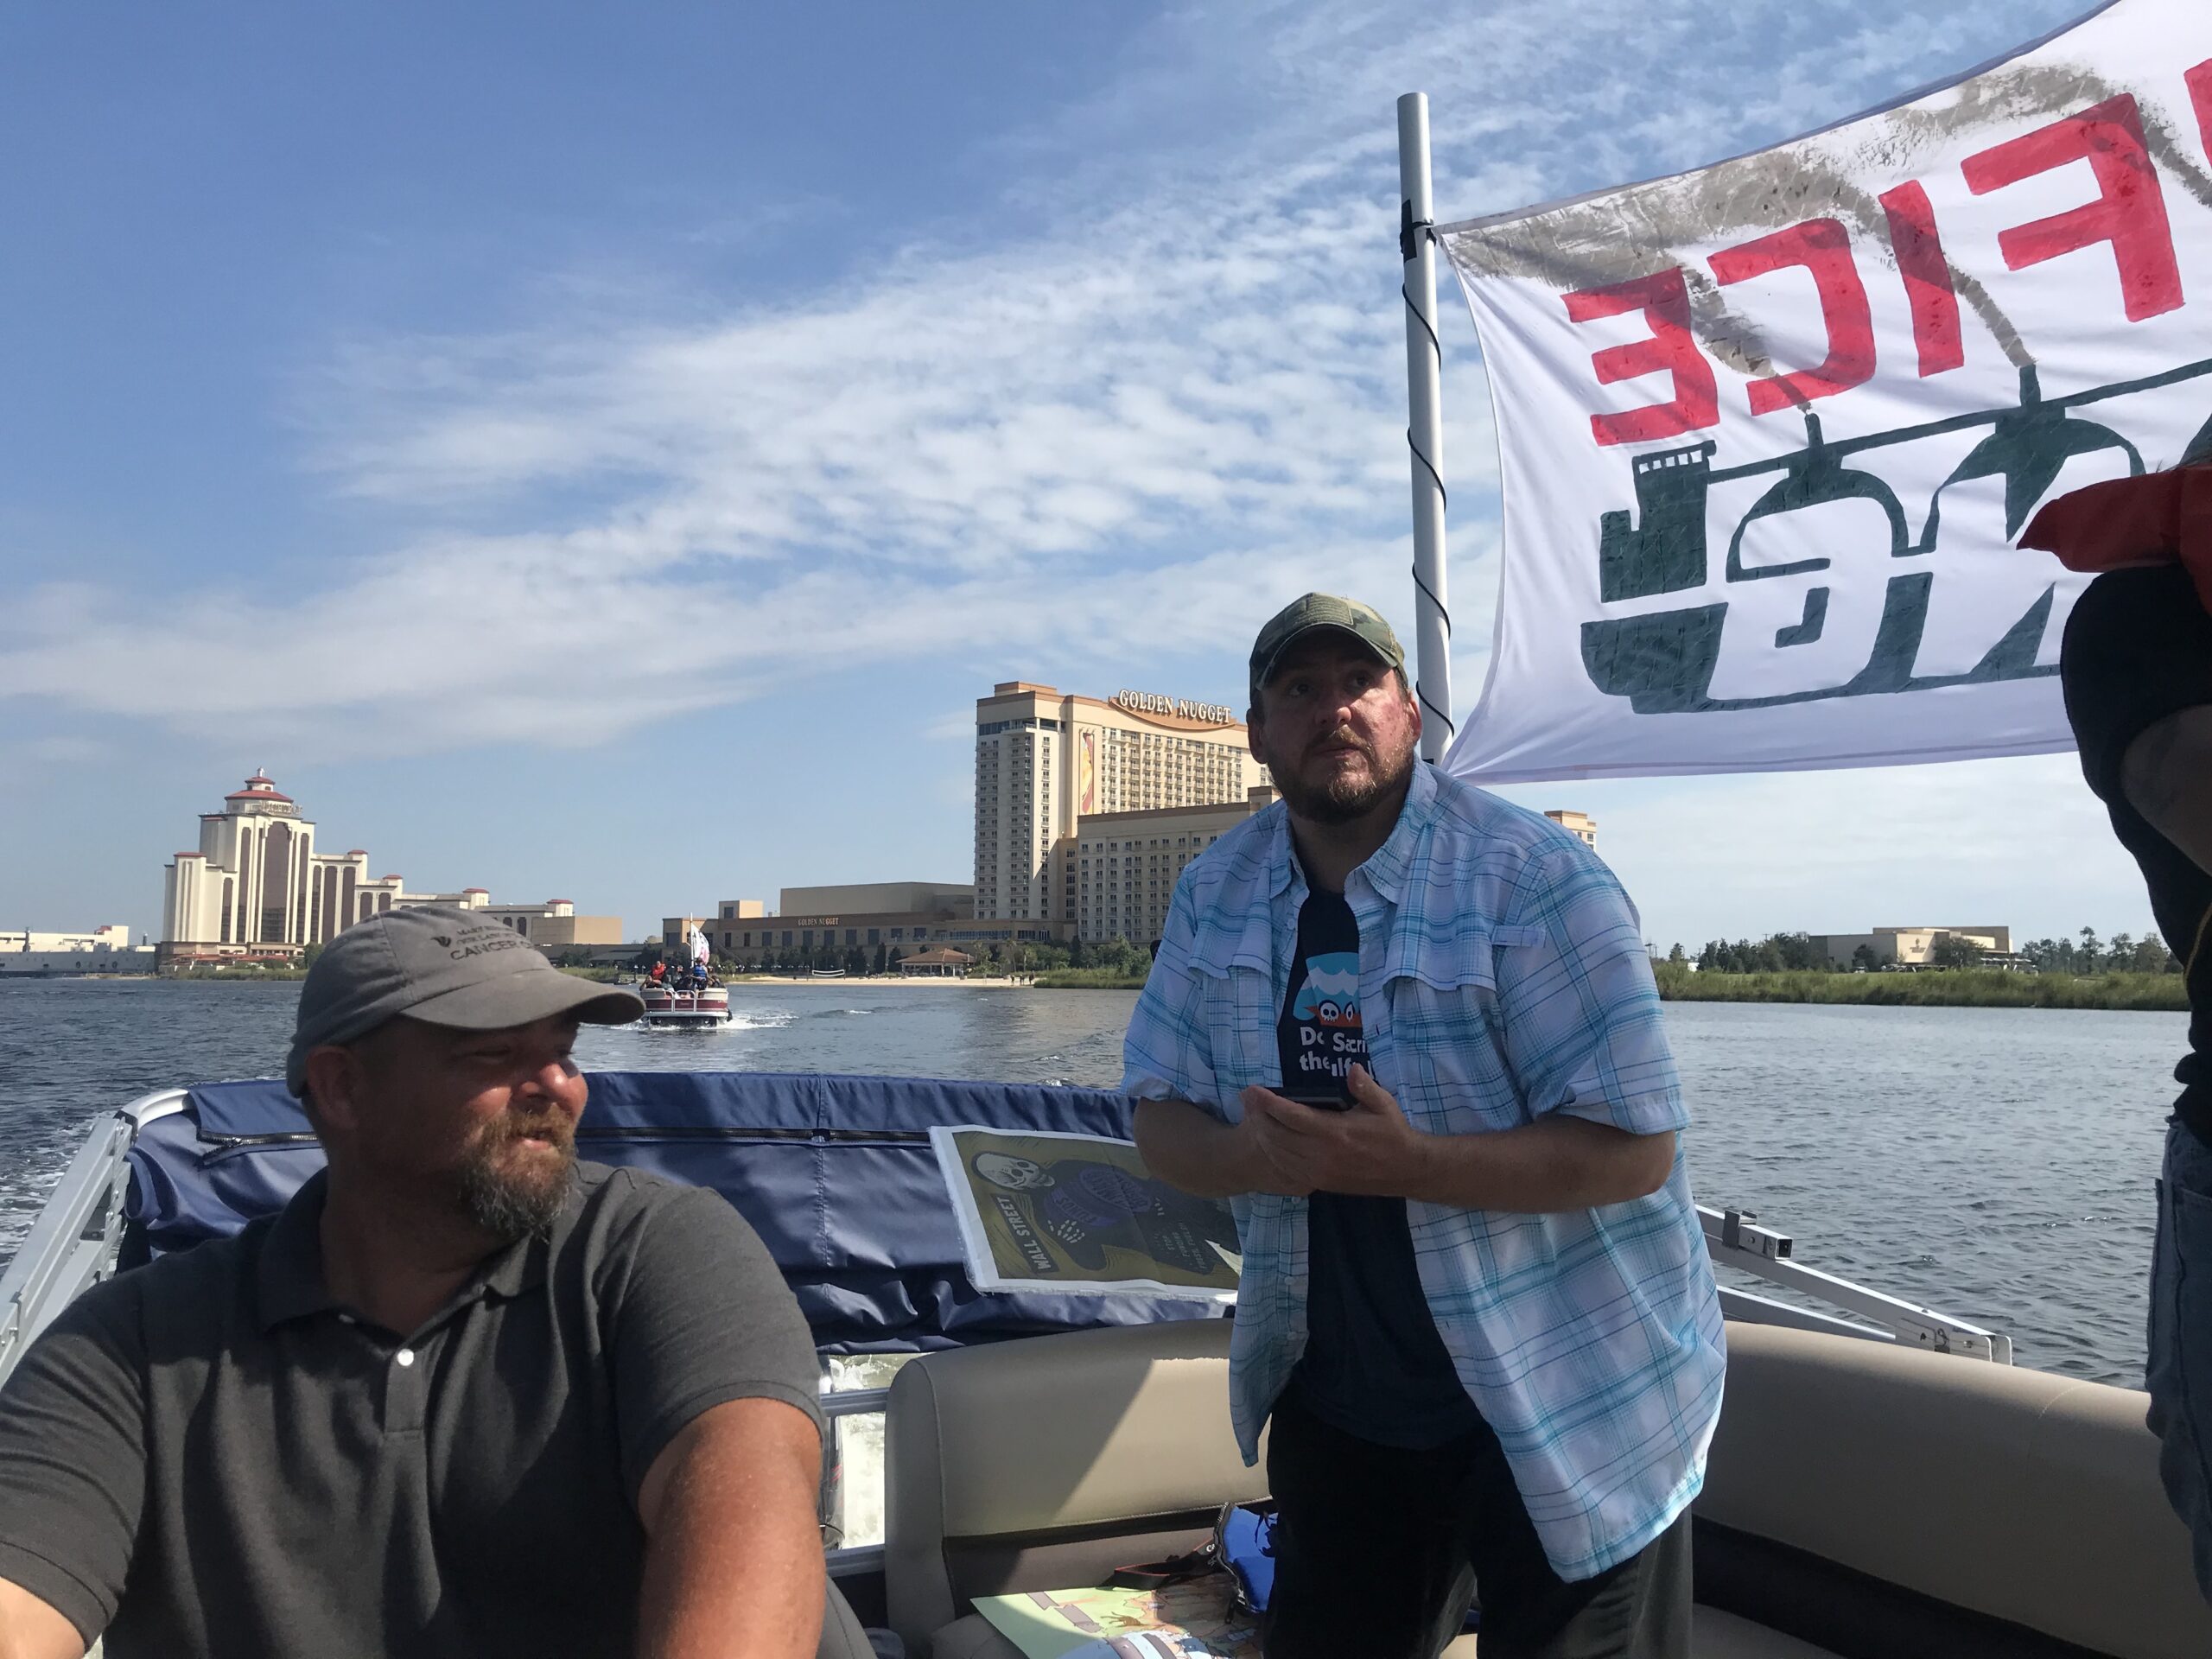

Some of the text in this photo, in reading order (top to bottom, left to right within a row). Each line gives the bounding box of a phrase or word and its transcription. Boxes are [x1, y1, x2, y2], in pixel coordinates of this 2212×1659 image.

[1119, 689, 1231, 723] GOLDEN NUGGET
[450, 940, 517, 960] CANCER
[996, 1196, 1052, 1271] WALL STREET
